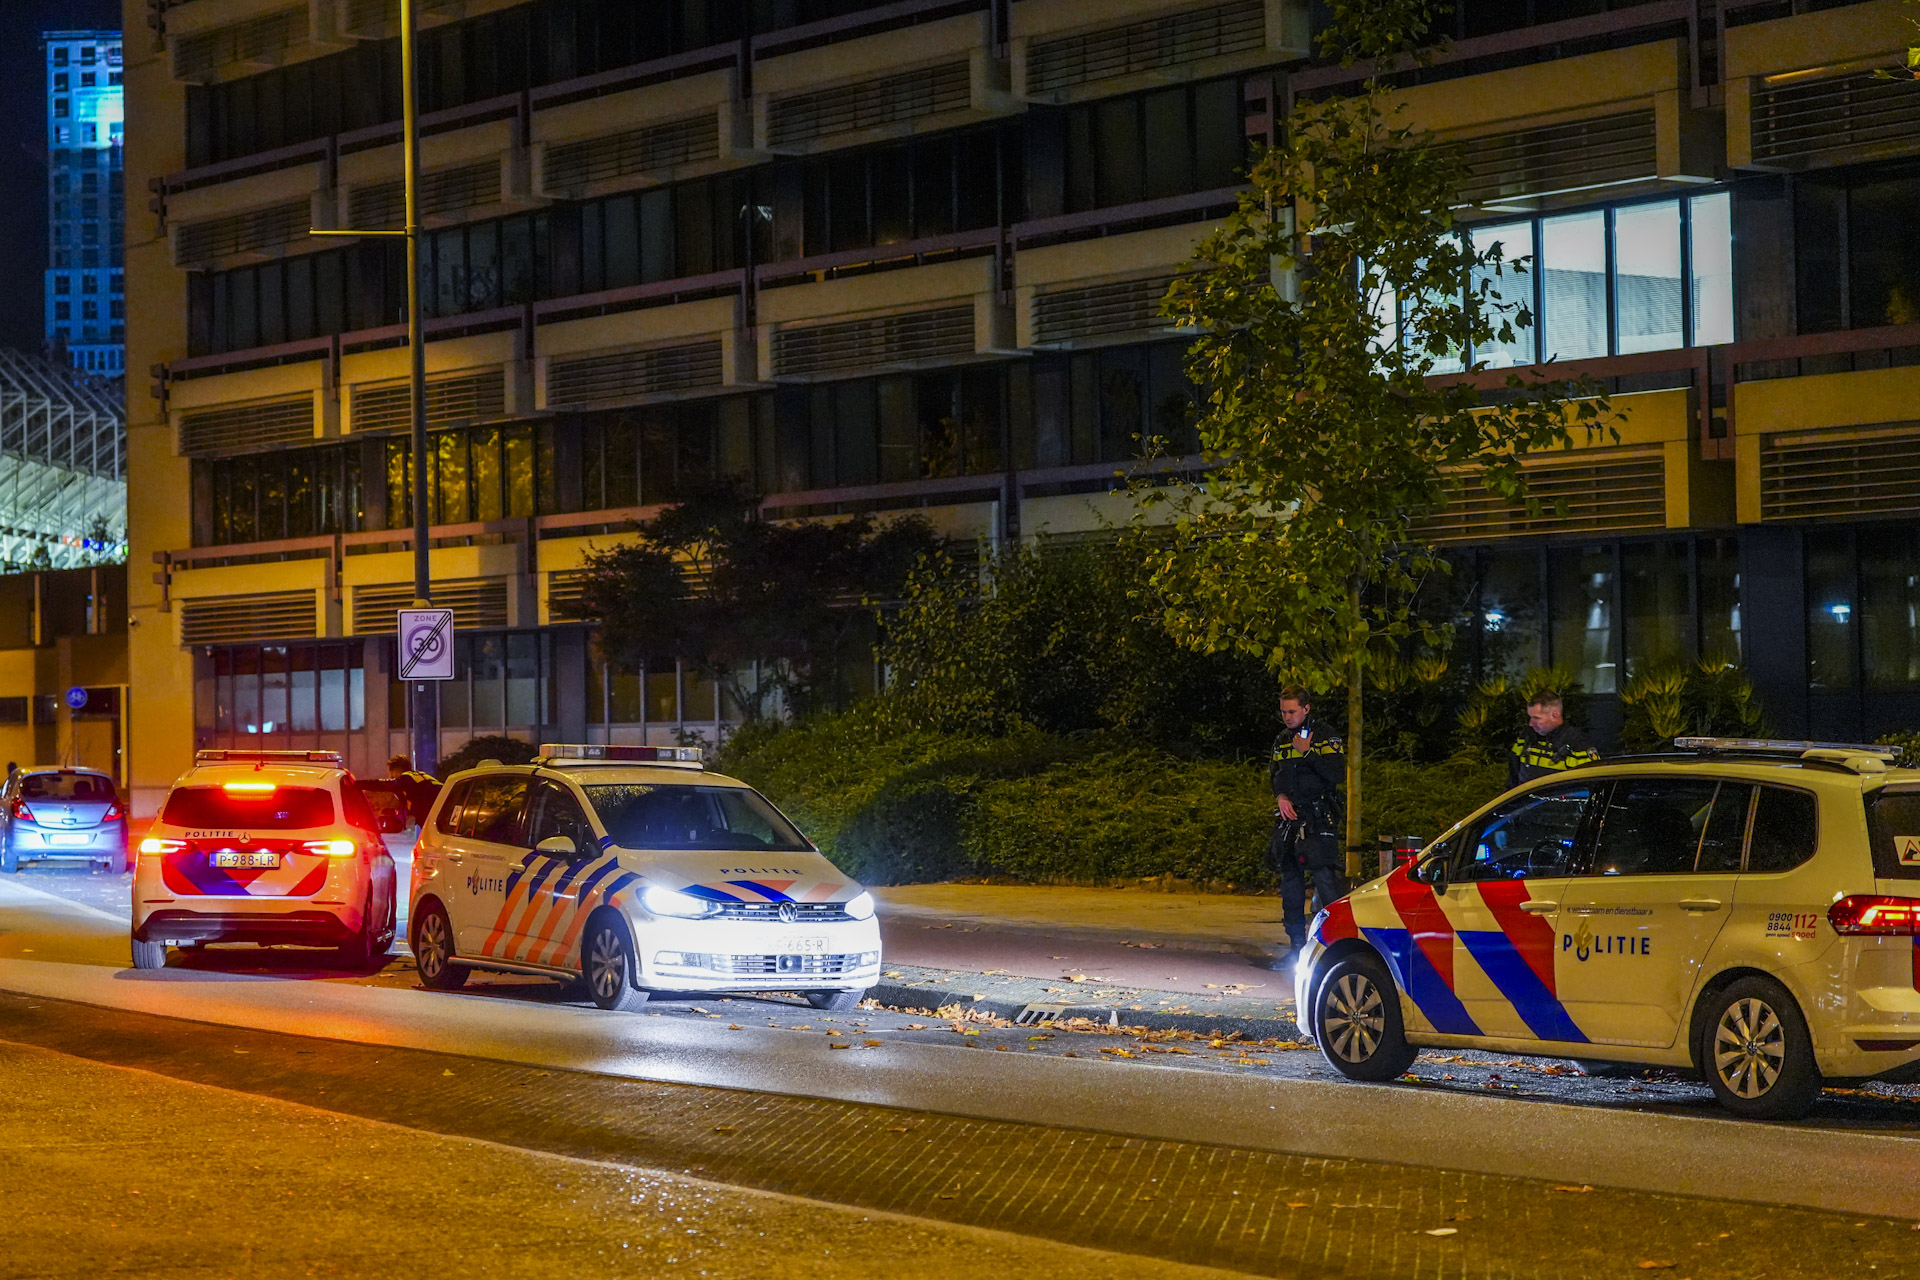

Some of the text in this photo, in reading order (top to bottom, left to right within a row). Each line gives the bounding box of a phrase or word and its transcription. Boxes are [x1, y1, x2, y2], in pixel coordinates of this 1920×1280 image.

[414, 637, 439, 652] 30
[220, 854, 275, 866] P-988-LR
[467, 876, 503, 895] POLITIE
[1768, 913, 1793, 921] 0900
[1794, 914, 1818, 928] 112
[1767, 922, 1791, 931] 8844
[1563, 934, 1650, 961] POLITIE
